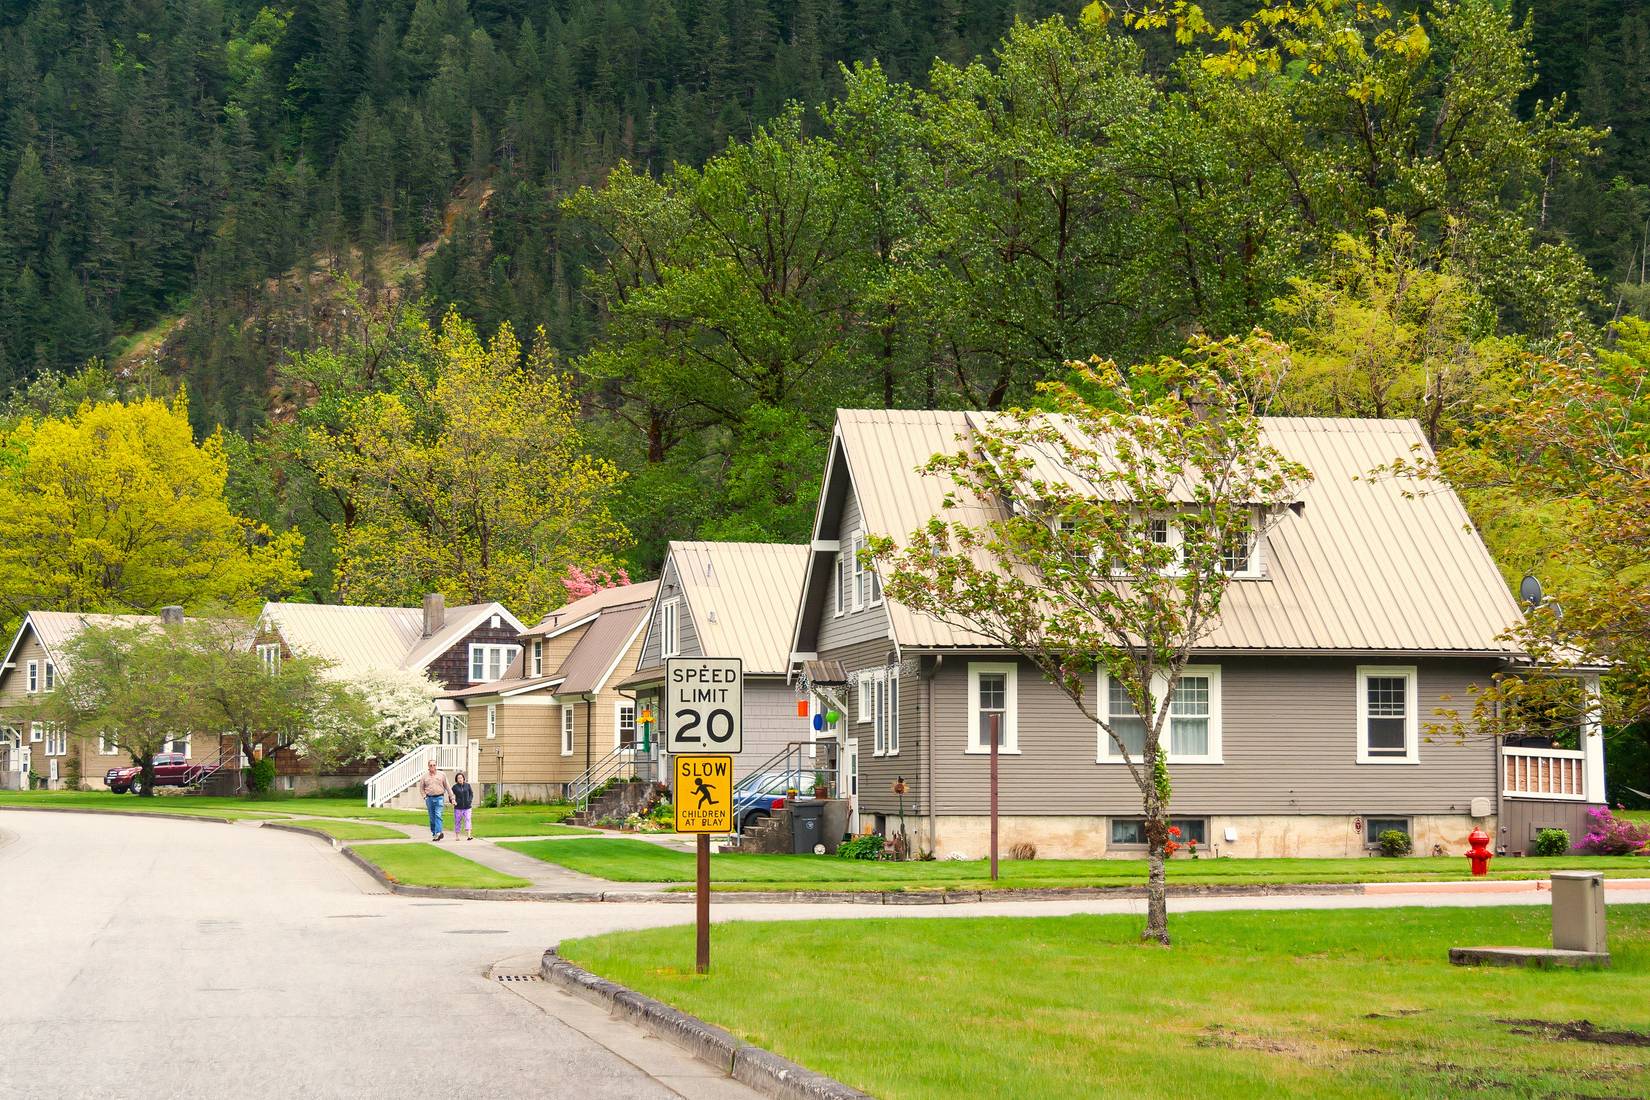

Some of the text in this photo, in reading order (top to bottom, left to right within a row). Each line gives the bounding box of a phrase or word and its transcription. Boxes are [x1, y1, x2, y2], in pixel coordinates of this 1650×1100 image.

[673, 668, 736, 683] SPEED
[680, 689, 728, 703] LIMIT
[674, 708, 735, 743] 20
[682, 762, 727, 777] SLOW
[682, 810, 726, 818] CHILDREN
[685, 818, 695, 827] AT
